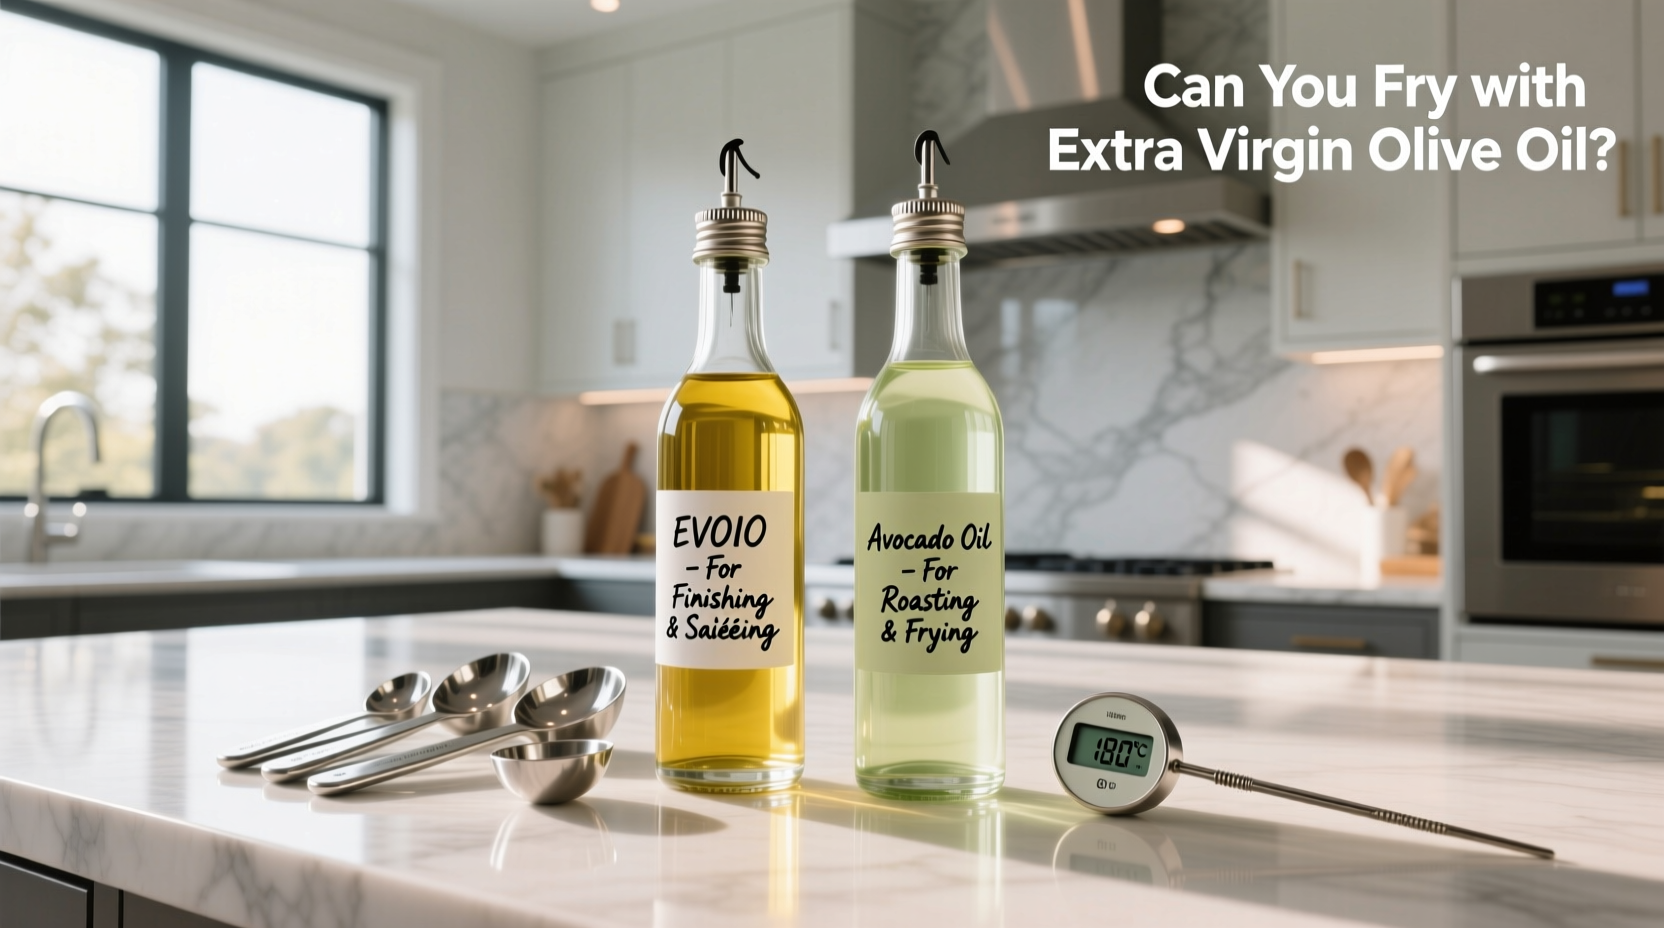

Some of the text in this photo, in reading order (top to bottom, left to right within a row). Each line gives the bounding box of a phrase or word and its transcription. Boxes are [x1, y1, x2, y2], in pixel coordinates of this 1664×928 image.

[673, 514, 767, 548] EVOIO
[867, 522, 993, 552] Avocado Oil
[705, 554, 743, 581] For
[922, 556, 959, 583] For
[672, 582, 775, 620] Finishing
[880, 584, 980, 622] Roasting
[666, 615, 679, 639] &
[880, 617, 979, 654] & Frying
